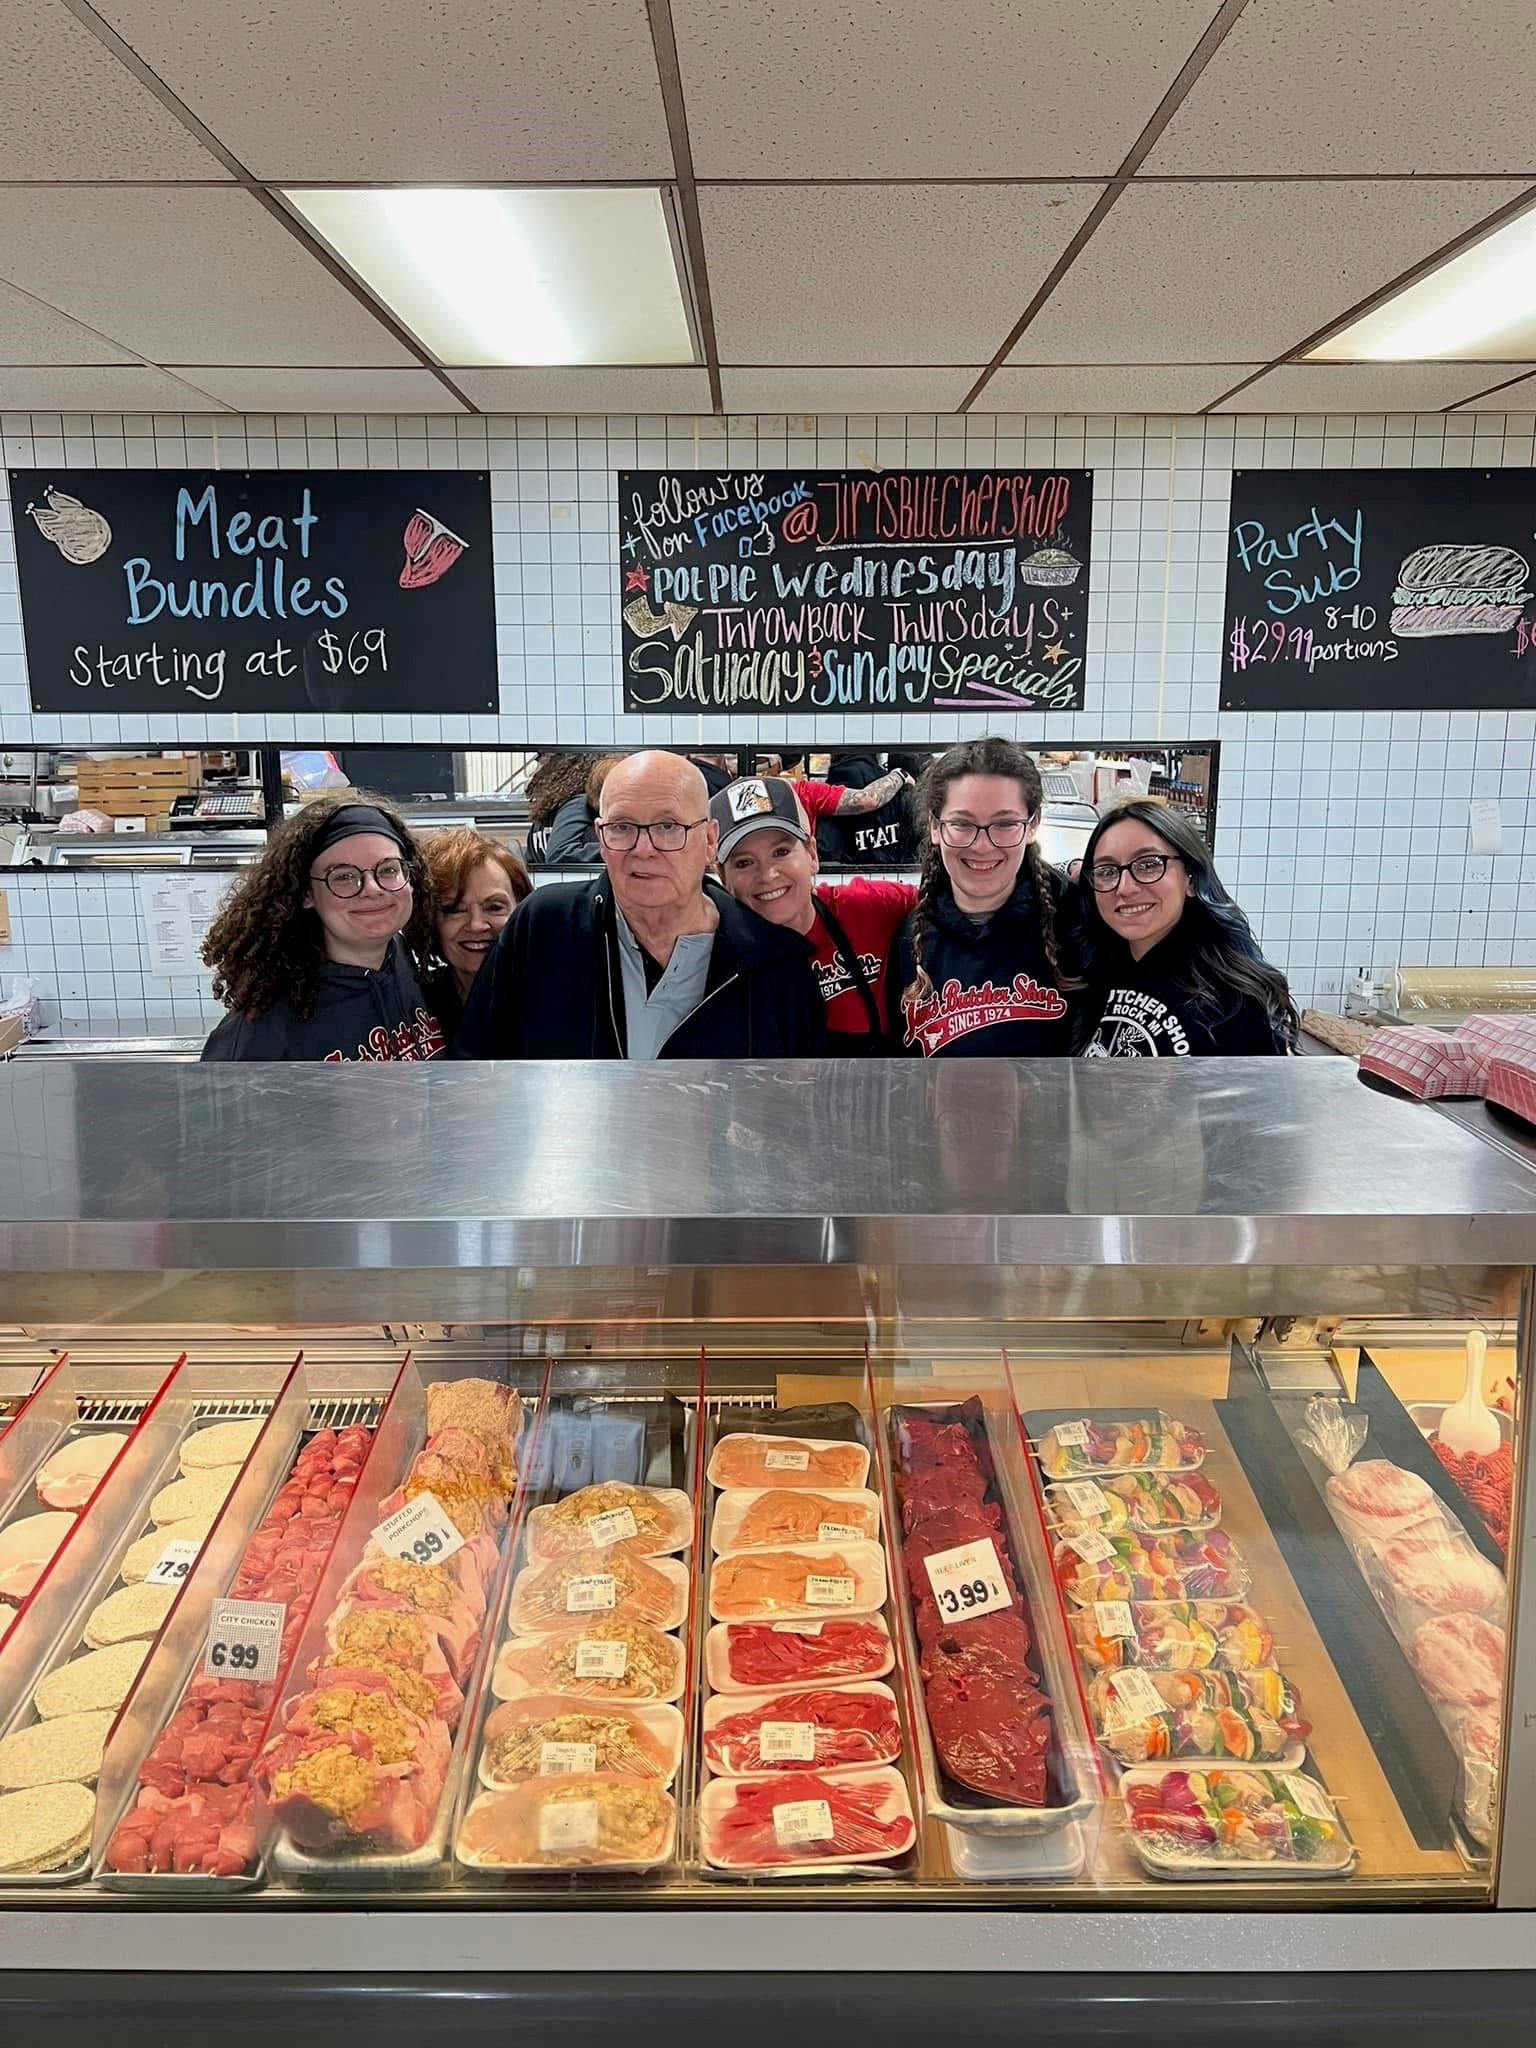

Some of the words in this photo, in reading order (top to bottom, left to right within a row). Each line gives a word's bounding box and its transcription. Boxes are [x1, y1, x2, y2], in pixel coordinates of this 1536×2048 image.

[175, 485, 318, 561] Meat
[633, 474, 731, 560] follow
[735, 474, 764, 500] us
[663, 531, 692, 557] on
[693, 480, 814, 548] Facebook
[1233, 507, 1362, 572] Party
[123, 556, 348, 624] Bundles
[1264, 561, 1361, 614] Sub
[1230, 616, 1314, 673] $29.99
[1309, 638, 1399, 673] portions
[1325, 604, 1376, 631] 8-10
[70, 642, 226, 699] Starting
[245, 638, 298, 677] at
[318, 627, 390, 675] $69
[629, 630, 805, 707] Saturday
[809, 642, 932, 706] Sunday
[931, 644, 1082, 709] Specials
[941, 978, 1013, 1017] Butcher
[1012, 973, 1063, 1014] Shop
[948, 1012, 981, 1036] SINCE
[984, 1008, 1011, 1023] 1974
[1147, 1019, 1164, 1037] MI
[1162, 1015, 1191, 1058] SHO
[382, 1507, 413, 1532] STUFFED
[220, 1615, 238, 1624] CITY
[241, 1617, 276, 1627] CHICKEN
